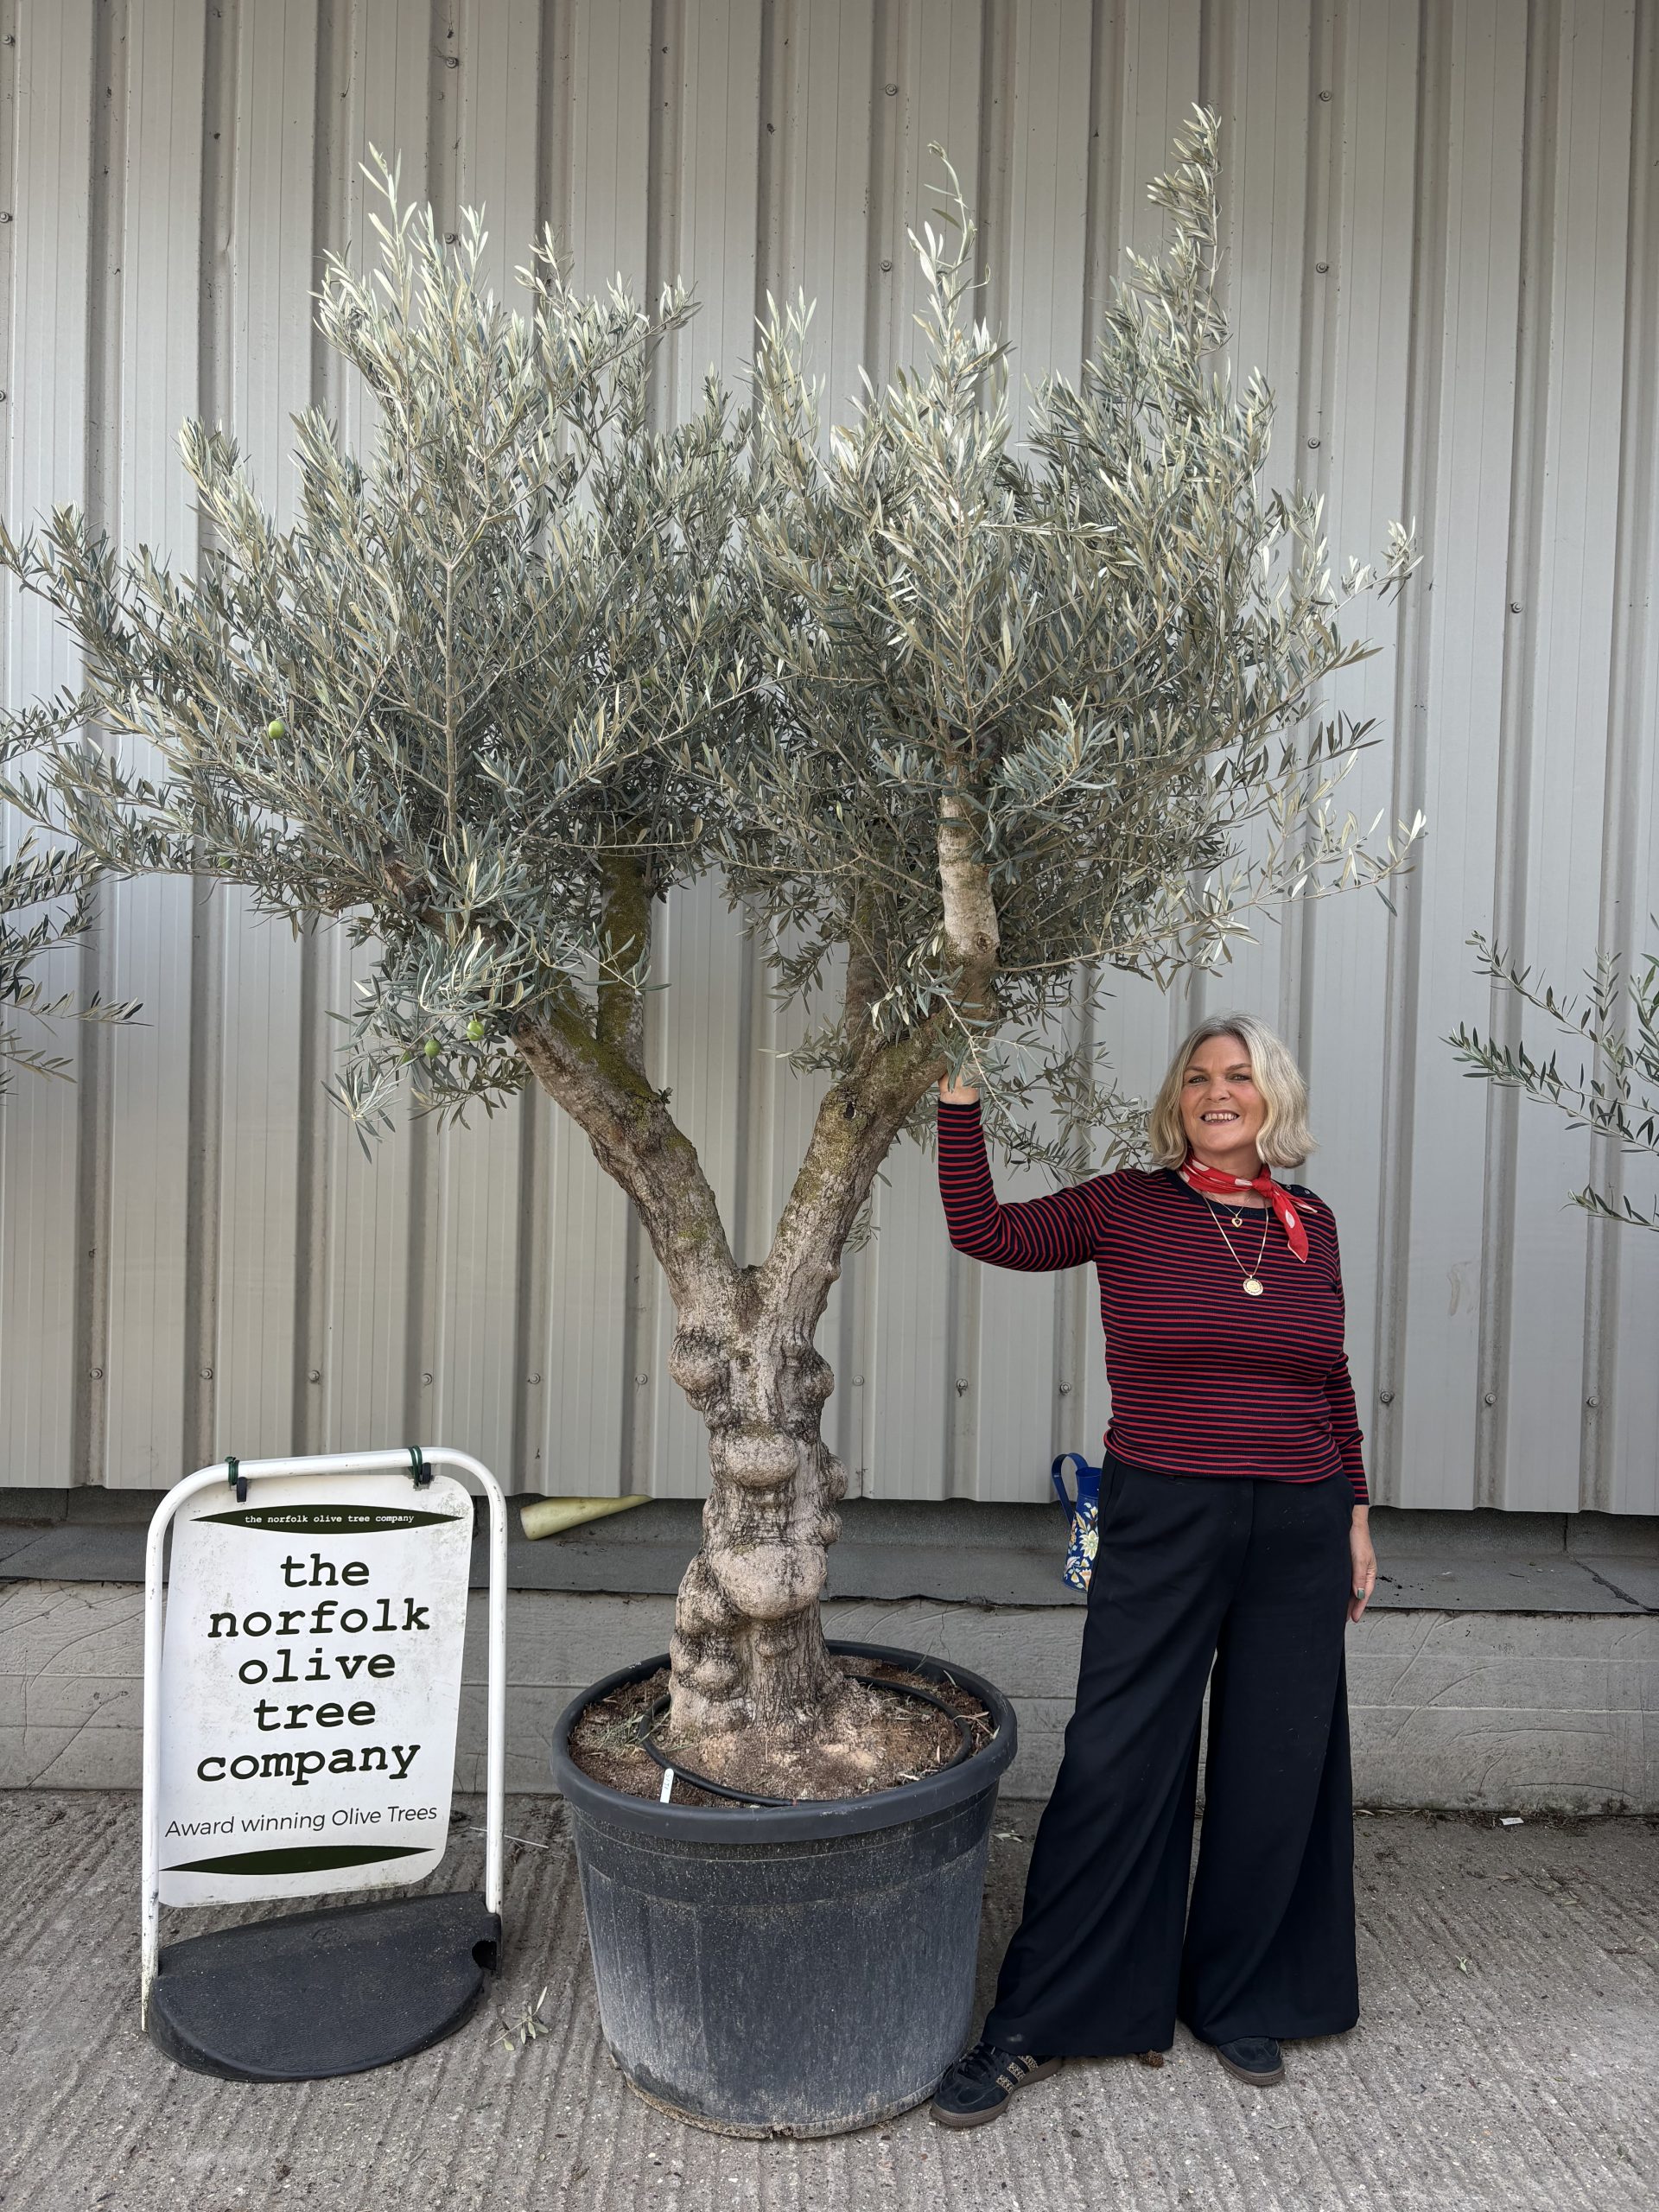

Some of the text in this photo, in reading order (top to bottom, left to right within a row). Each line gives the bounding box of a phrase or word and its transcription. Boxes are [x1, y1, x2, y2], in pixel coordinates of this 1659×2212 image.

[245, 1515, 263, 1523] the
[267, 1515, 308, 1523] norfolk
[375, 1515, 415, 1524] company
[280, 1553, 370, 1588] the
[207, 1598, 430, 1638] norfolk
[238, 1647, 396, 1685] olive
[253, 1699, 376, 1732] tree
[197, 1745, 421, 1786] company
[164, 1805, 438, 1838] Award winning Olive Trees
